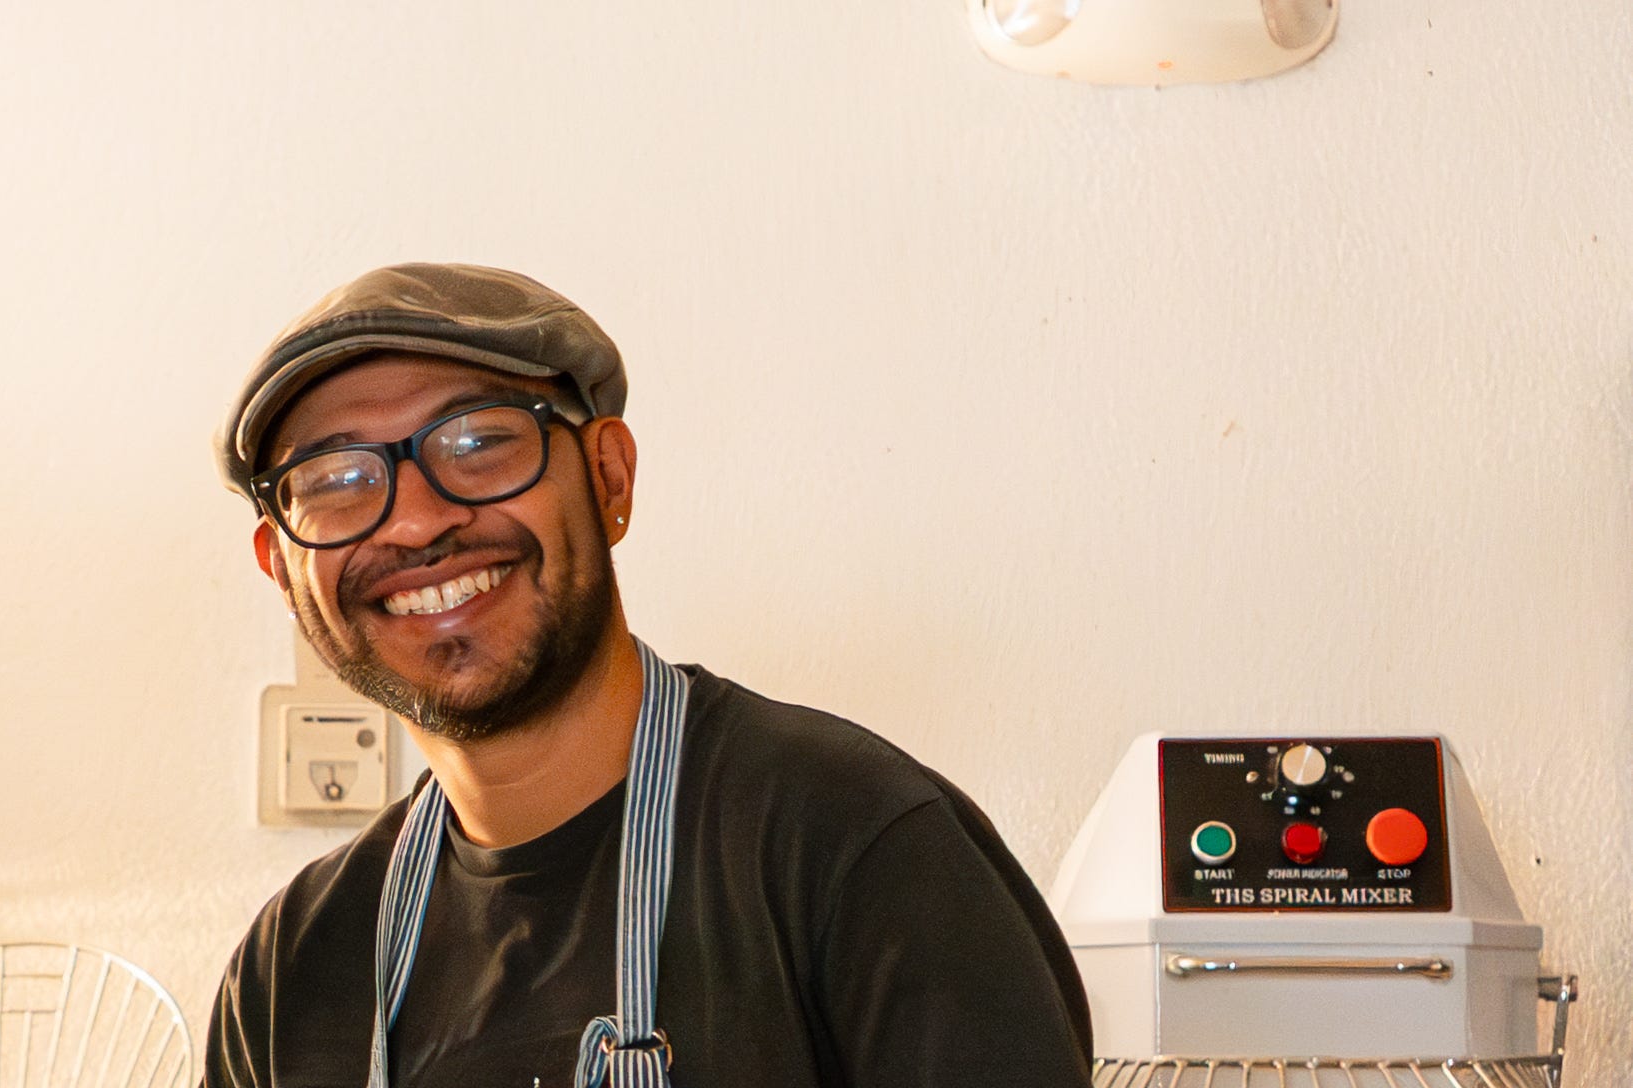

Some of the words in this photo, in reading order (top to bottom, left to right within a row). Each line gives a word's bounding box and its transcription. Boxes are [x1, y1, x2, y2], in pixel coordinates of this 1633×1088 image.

[1194, 868, 1235, 880] START
[1377, 868, 1412, 880] STOP
[1260, 887, 1336, 904] SPIRAL
[1341, 887, 1414, 904] MIXER
